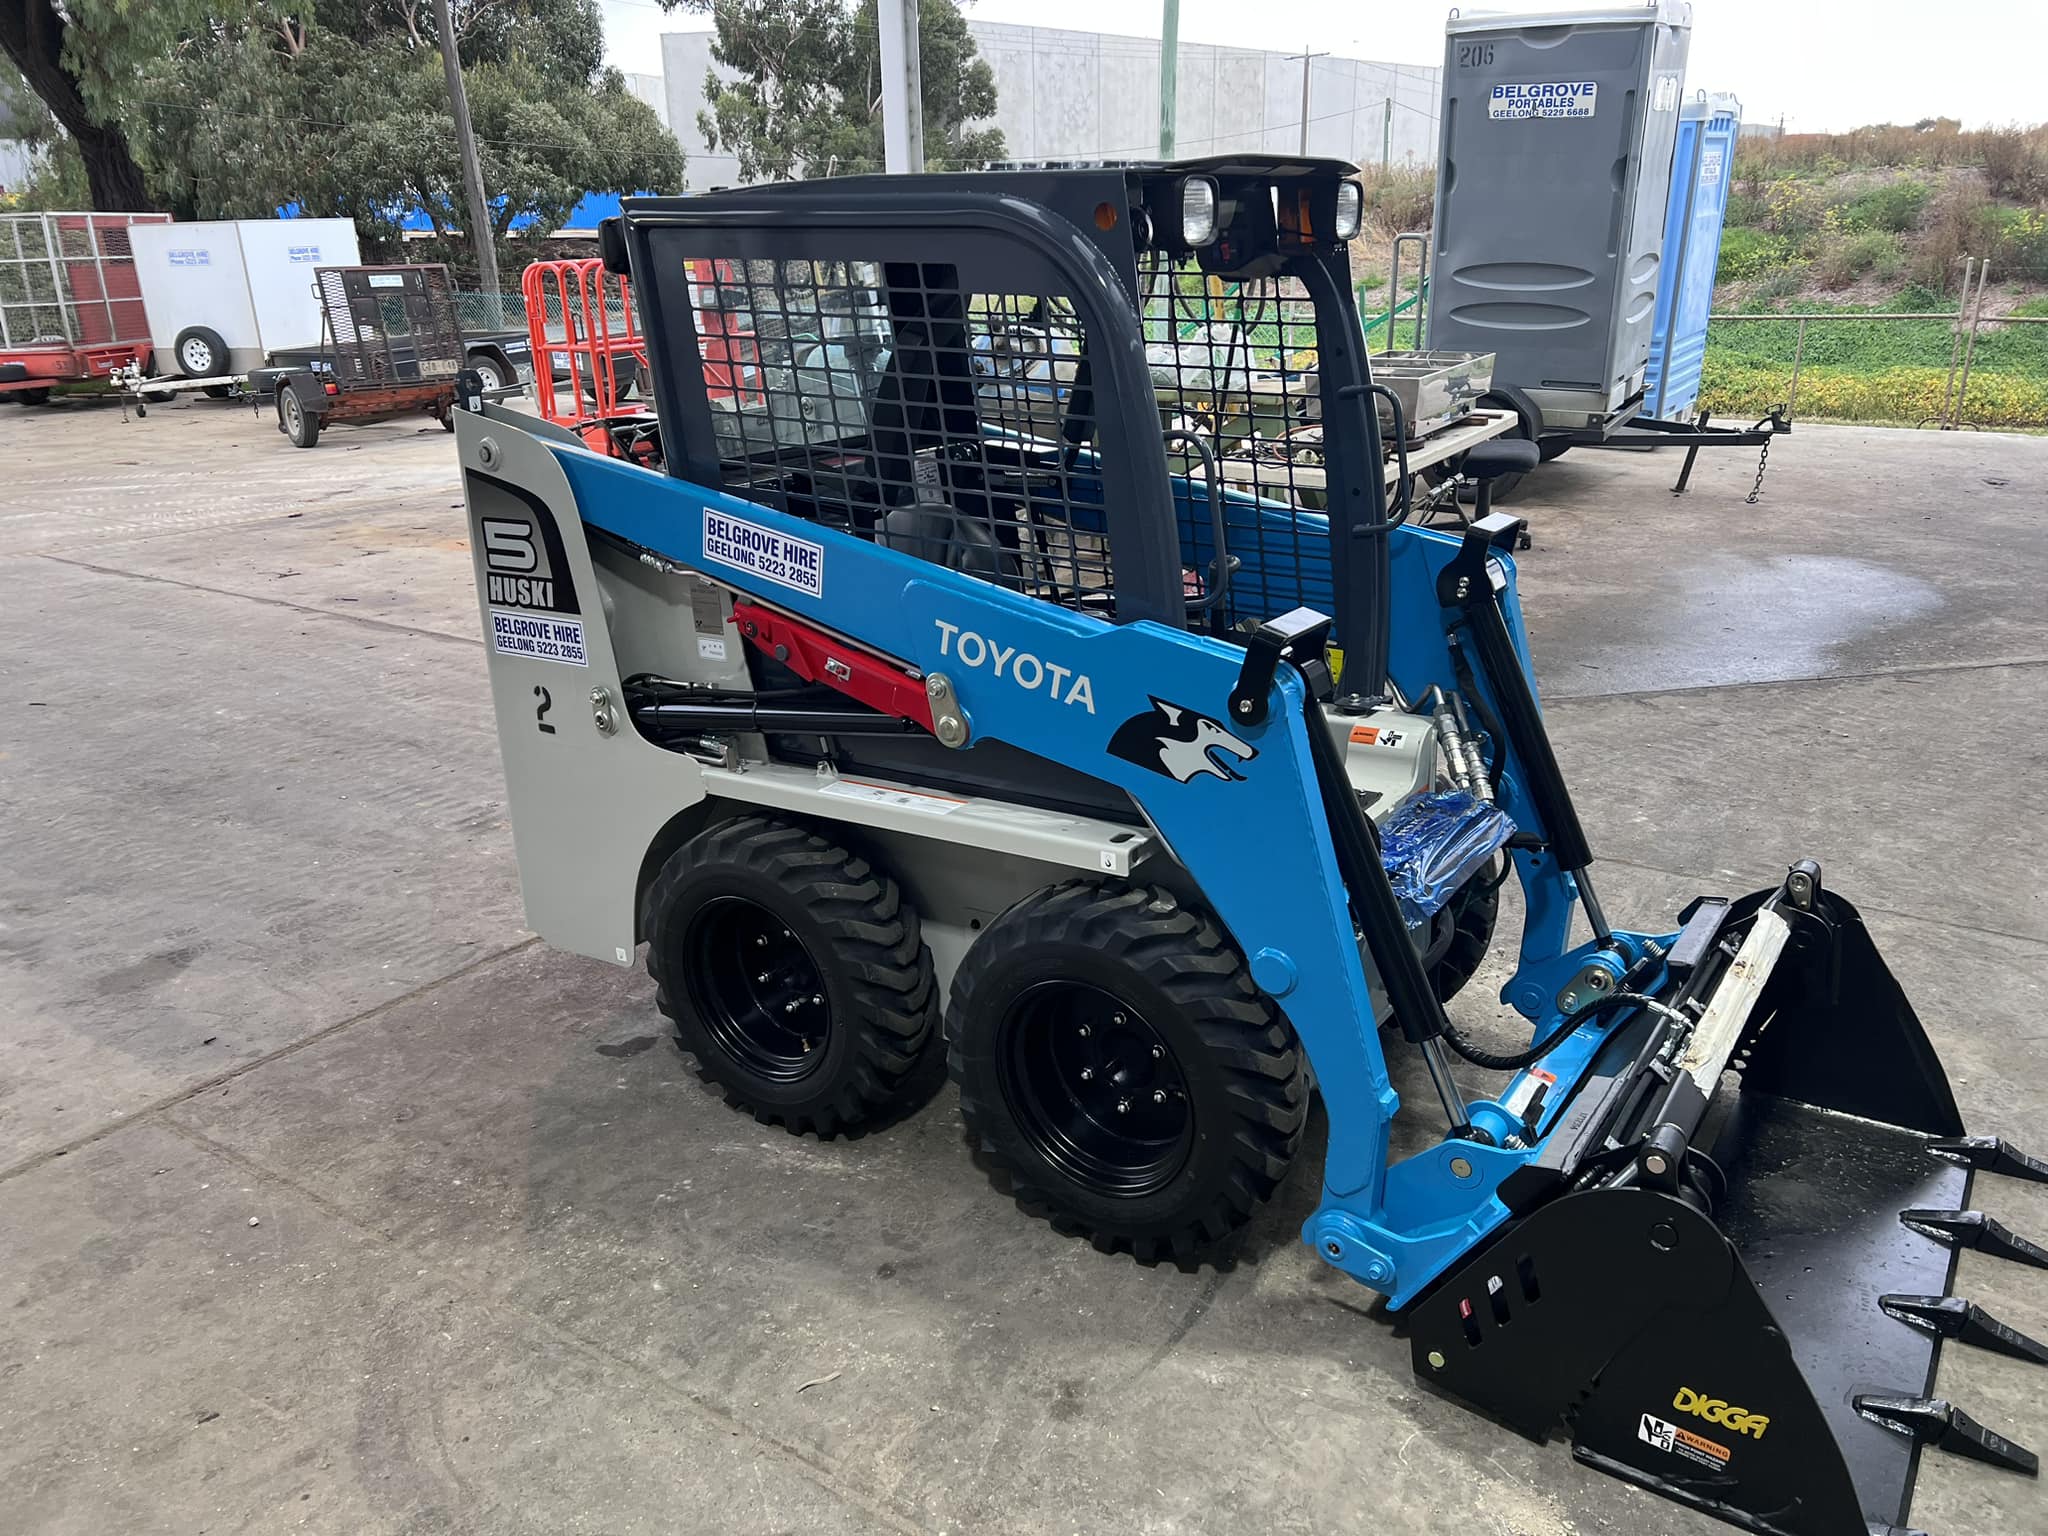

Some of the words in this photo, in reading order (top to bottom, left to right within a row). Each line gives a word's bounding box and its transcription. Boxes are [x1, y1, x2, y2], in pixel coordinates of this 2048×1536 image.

[1460, 44, 1494, 68] 206
[1493, 83, 1595, 99] BELGROVE
[1507, 97, 1575, 109] PORTABLES
[1493, 109, 1539, 118] GEELONG
[1542, 109, 1565, 117] 5229
[482, 518, 537, 573] 5
[707, 517, 780, 558] BELGROVE
[783, 542, 818, 571] HIRE
[707, 537, 756, 567] GEELONG
[758, 555, 786, 578] 5223
[788, 566, 817, 588] 2855
[489, 575, 554, 608] HUSKI
[494, 616, 551, 640] BELGROVE
[552, 625, 581, 645] HIRE
[496, 634, 535, 652] GEELONG
[536, 641, 560, 656] 5223
[560, 646, 583, 661] 2855
[935, 619, 1096, 715] TOYOTA
[533, 684, 556, 735] 2
[1672, 1386, 1771, 1440] DIGGA
[1685, 1434, 1729, 1459] WARNING
